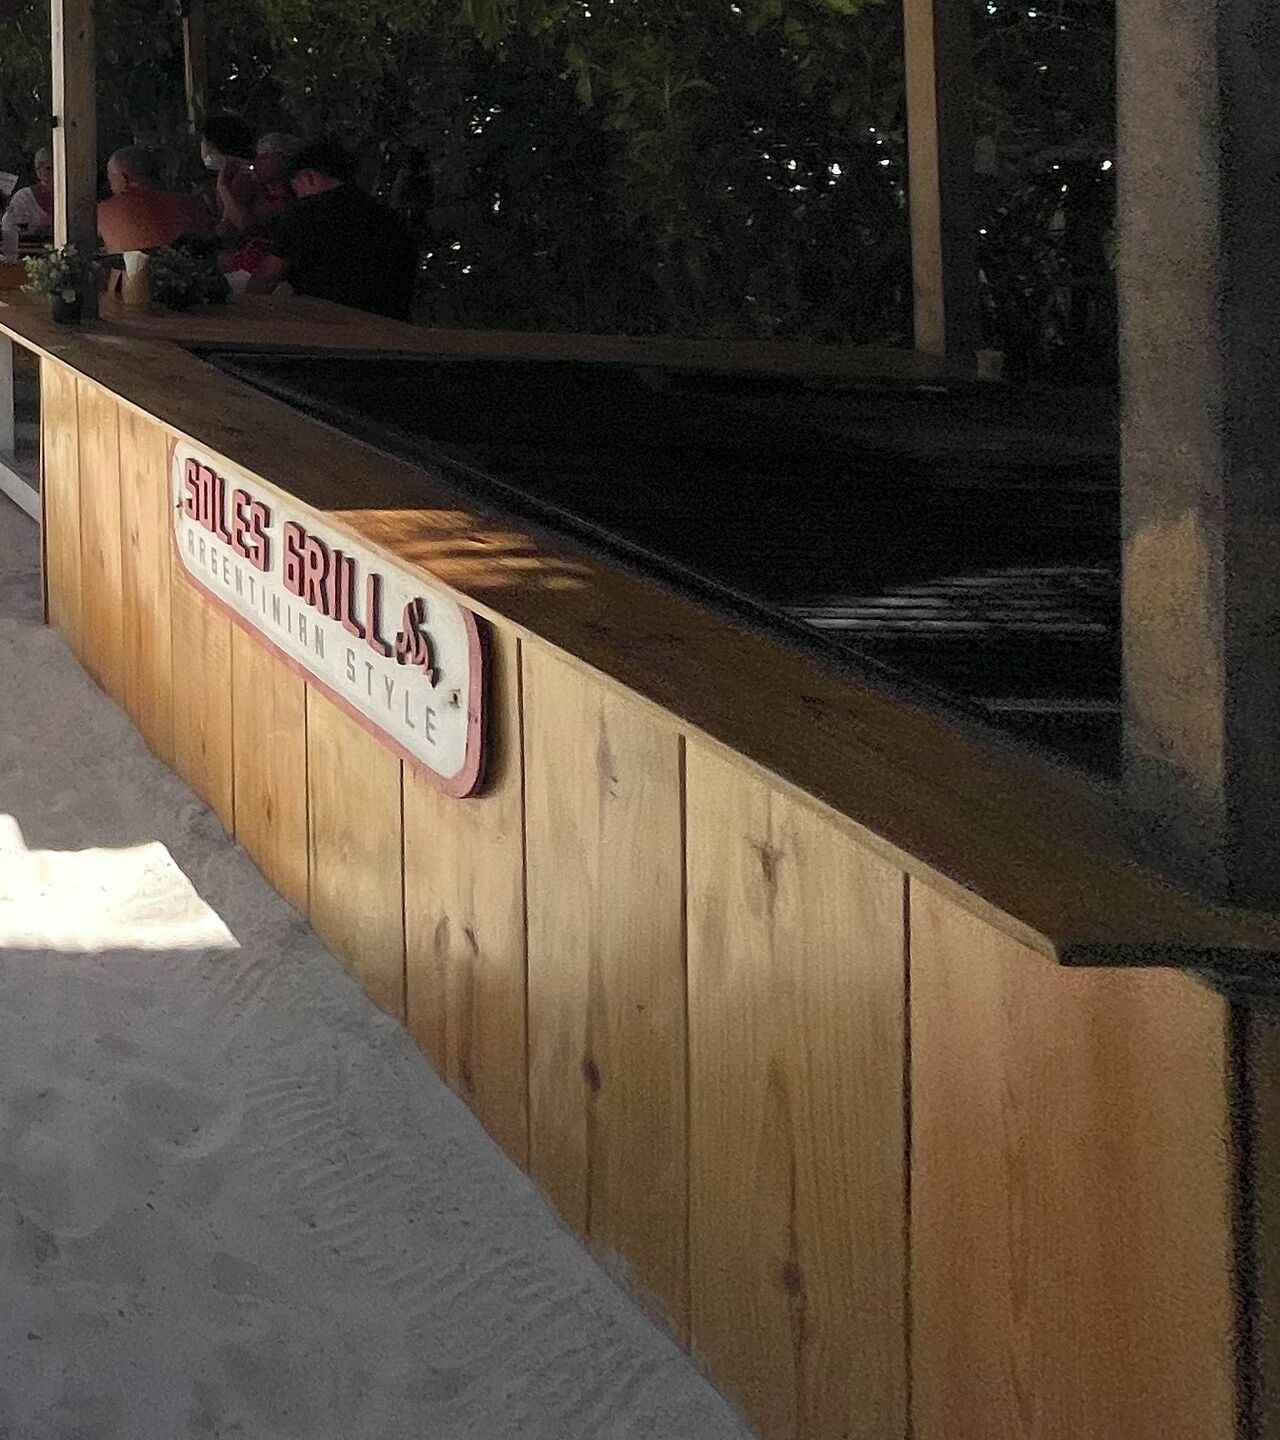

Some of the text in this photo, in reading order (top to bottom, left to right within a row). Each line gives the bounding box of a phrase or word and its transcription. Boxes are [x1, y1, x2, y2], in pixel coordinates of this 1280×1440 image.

[184, 457, 393, 658] SOLES GRILL
[187, 529, 437, 746] ARGENTINIAN STYLE
